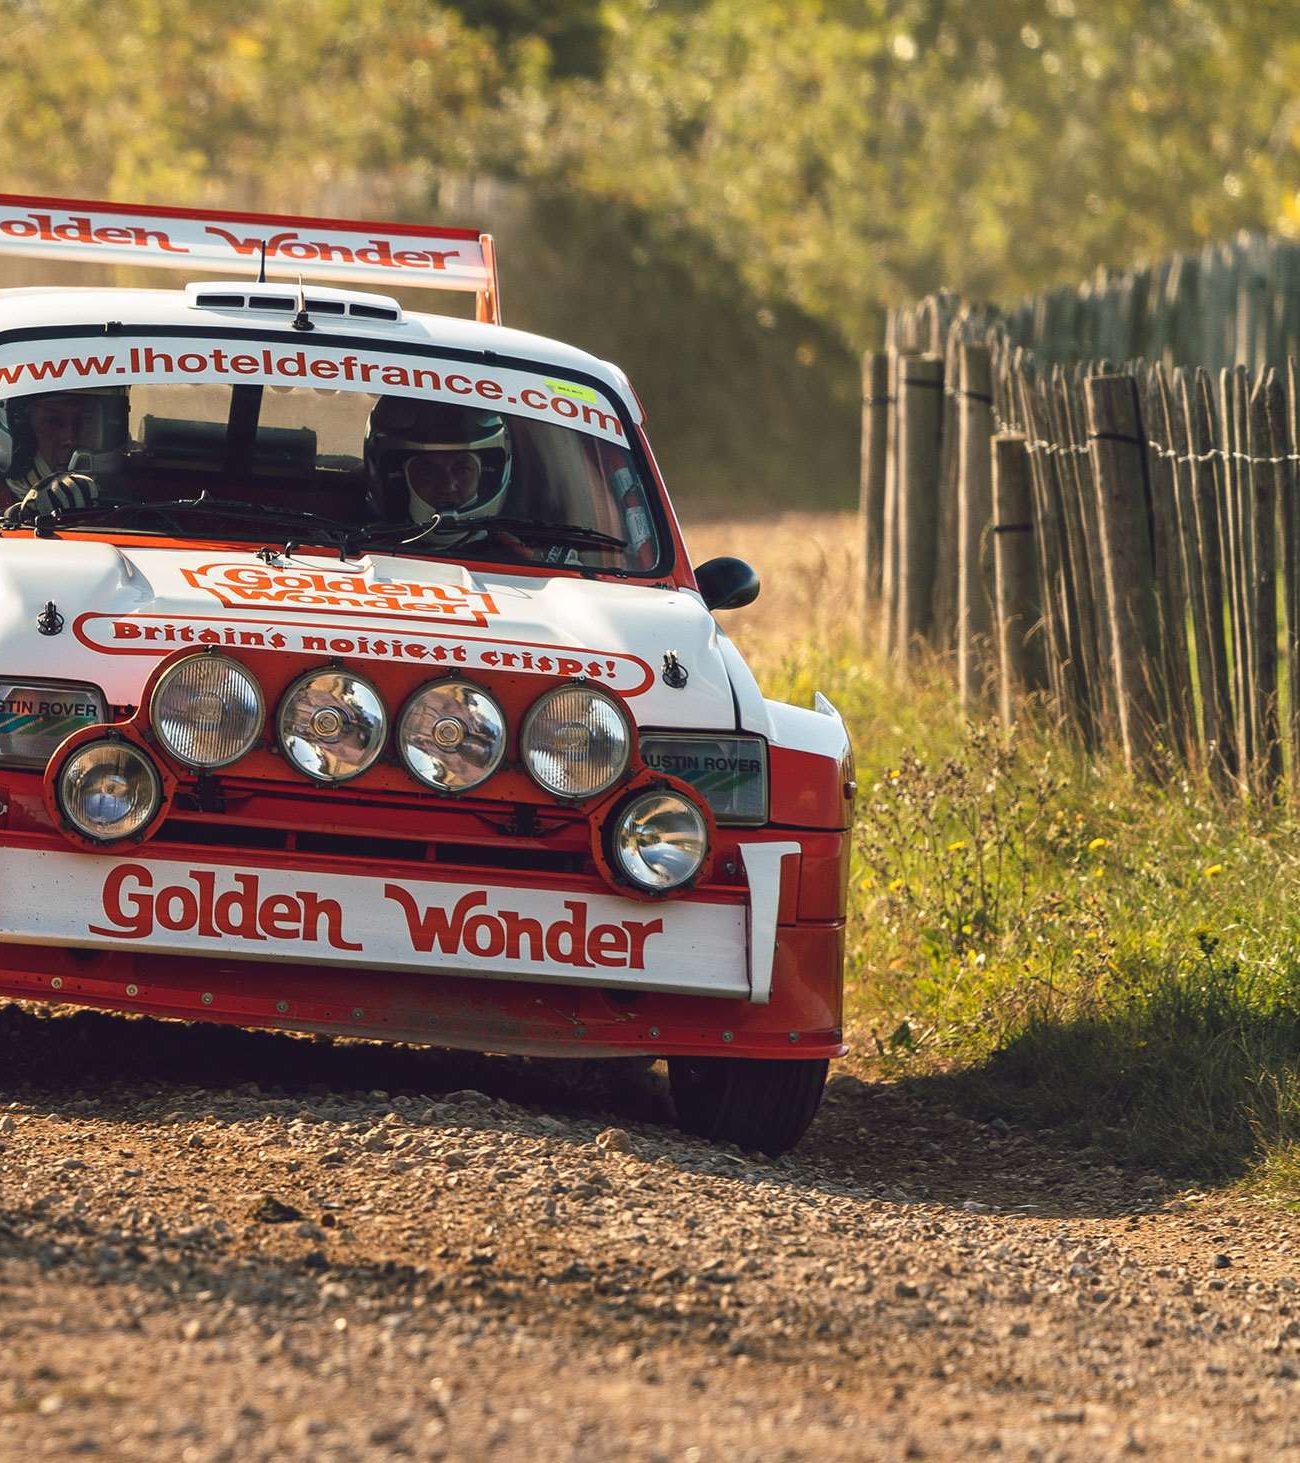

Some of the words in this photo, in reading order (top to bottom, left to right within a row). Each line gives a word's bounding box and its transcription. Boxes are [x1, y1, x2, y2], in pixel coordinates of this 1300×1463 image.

[205, 226, 460, 270] Wonder
[214, 583, 469, 614] Wonder
[224, 568, 467, 602] Golden
[112, 621, 287, 650] Britain's
[302, 635, 467, 663] noisiest
[480, 648, 617, 679] crisps!
[38, 701, 98, 717] ROVER
[703, 757, 762, 773] ROVER
[88, 863, 363, 952] Golden
[384, 883, 664, 970] Wonder
